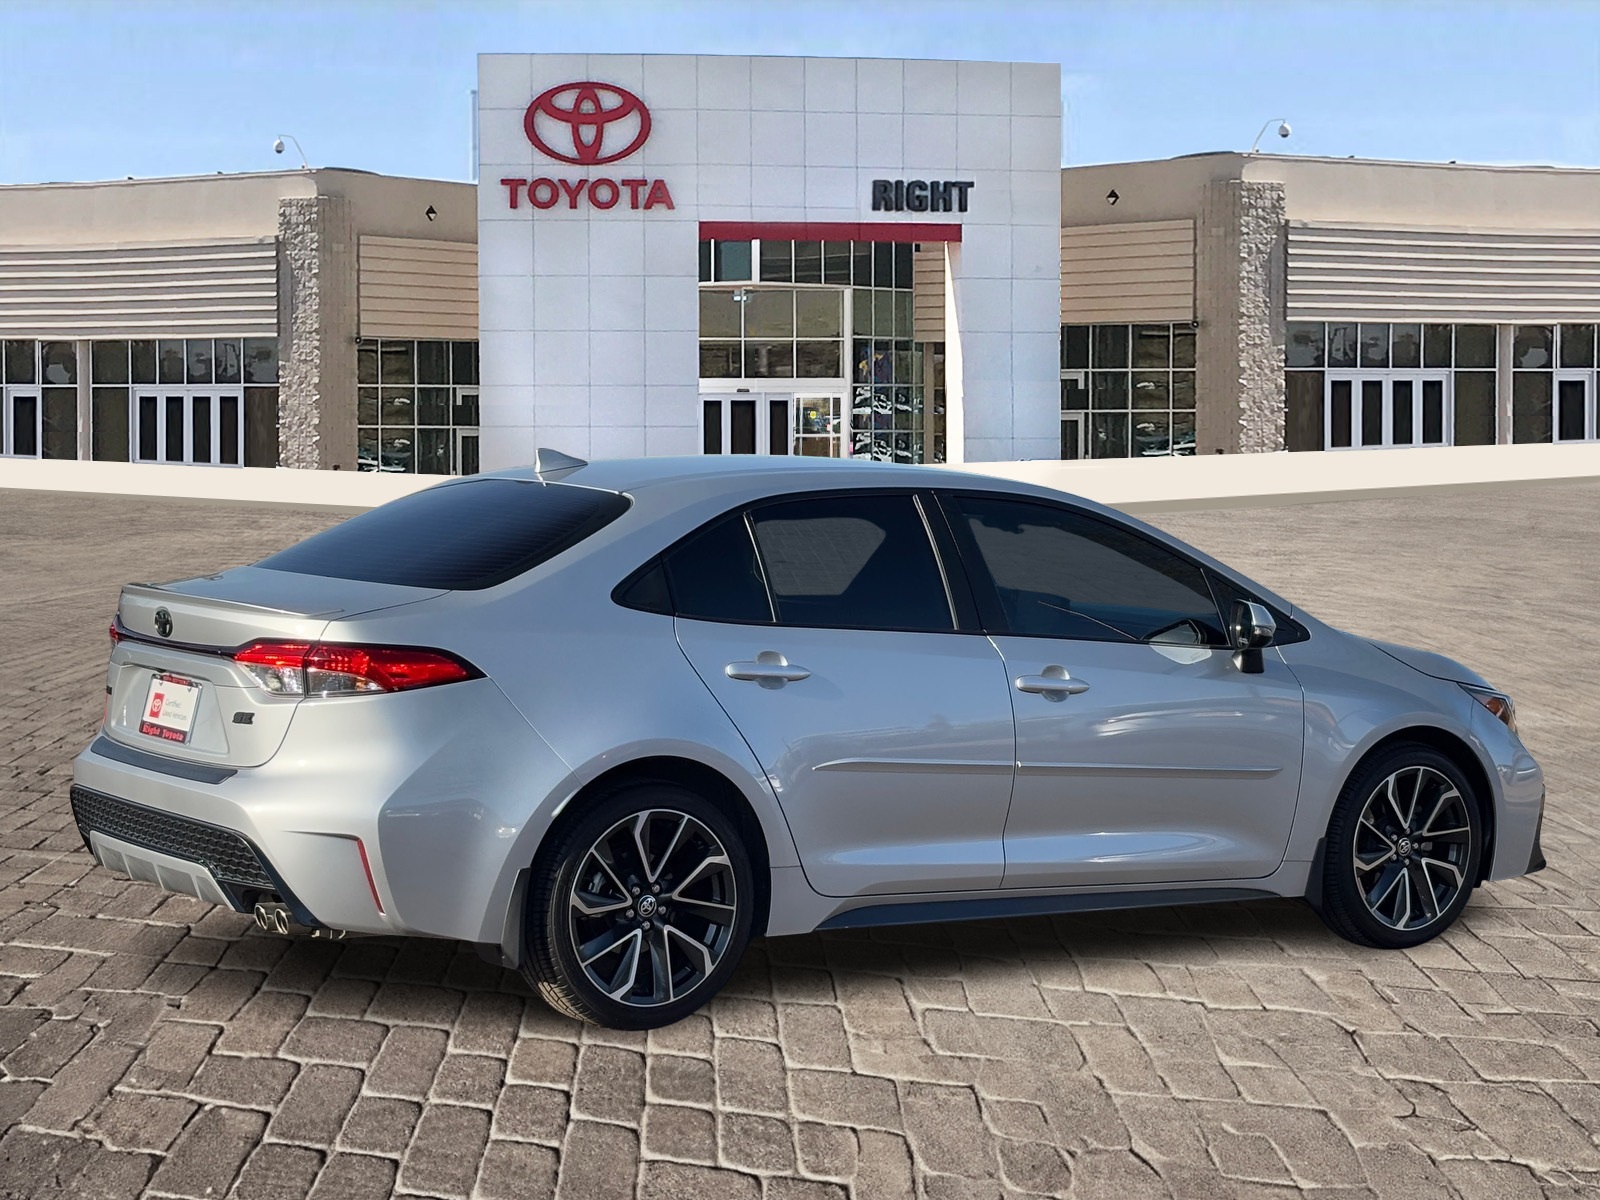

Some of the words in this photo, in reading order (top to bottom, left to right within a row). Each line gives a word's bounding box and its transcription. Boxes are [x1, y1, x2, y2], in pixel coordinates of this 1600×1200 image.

[501, 178, 675, 210] TOYOTA
[872, 179, 974, 212] RIGHT
[142, 723, 160, 736] Right
[162, 728, 184, 741] Toyota
